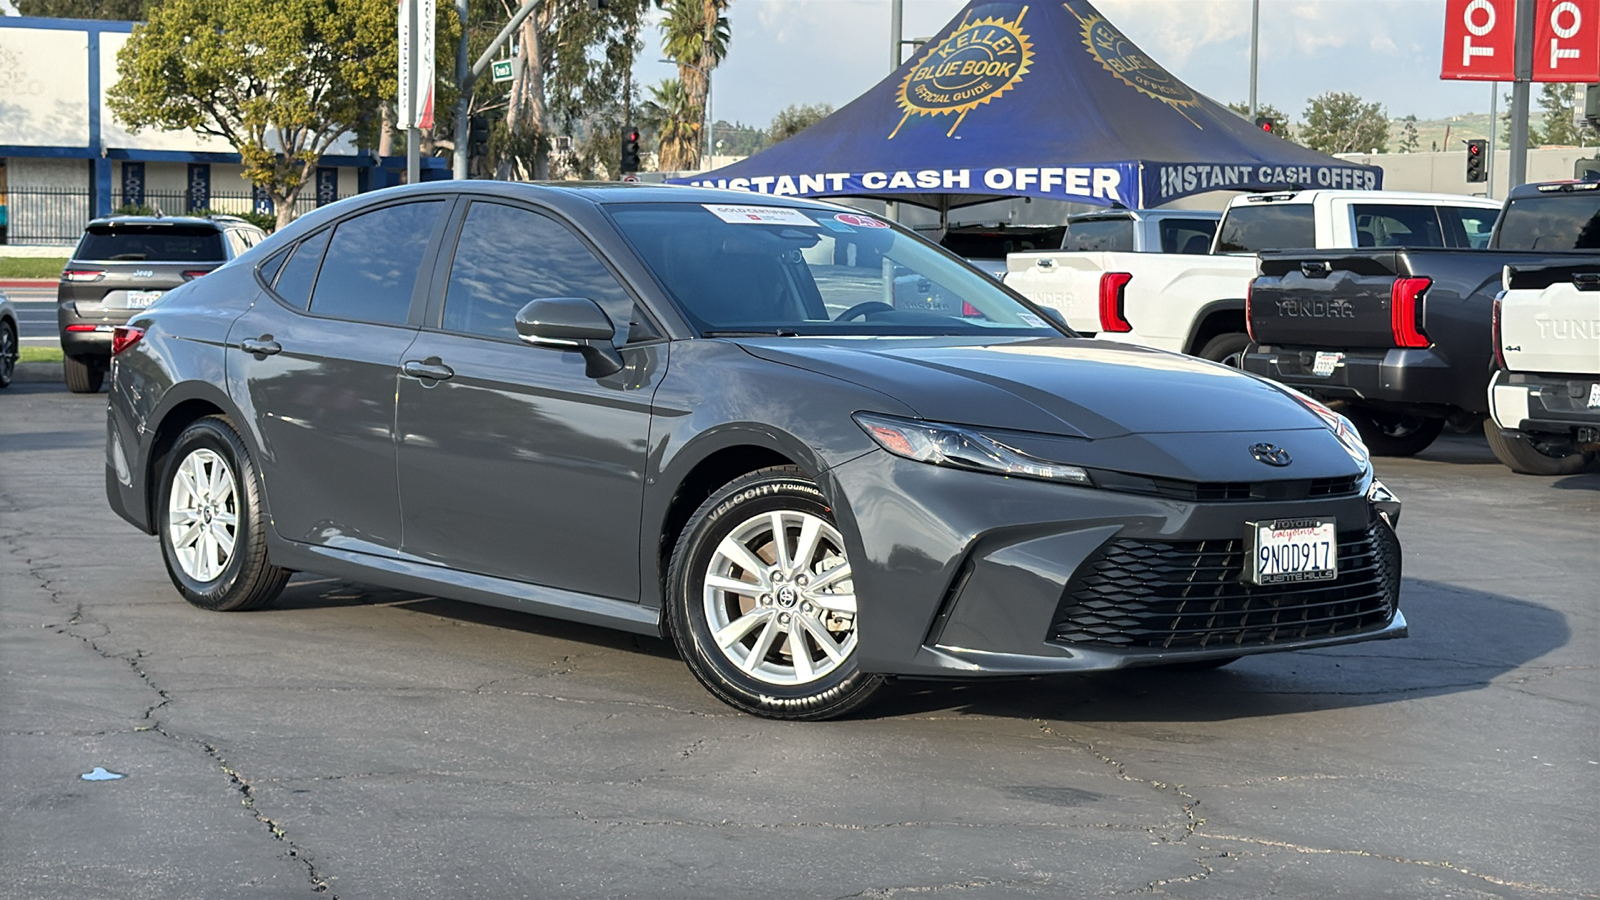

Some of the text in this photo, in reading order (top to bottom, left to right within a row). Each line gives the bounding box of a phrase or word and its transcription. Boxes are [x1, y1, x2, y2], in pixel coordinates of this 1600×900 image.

[938, 29, 1017, 58] KELLEY
[1096, 25, 1121, 51] KEL
[913, 60, 1017, 82] BLUE BOOK
[1107, 54, 1149, 73] BLUE
[914, 81, 993, 103] OFFICIAL GUIDE
[861, 168, 970, 190] CASH
[983, 166, 1121, 200] OFFER
[1160, 165, 1376, 198] INSTANT CASH OFFER
[133, 269, 154, 277] Jeep
[1275, 299, 1355, 318] TUNDRA
[781, 483, 819, 496] TOURING
[1276, 520, 1317, 529] TOYOTA
[1262, 570, 1333, 583] PUENTE HILLS
